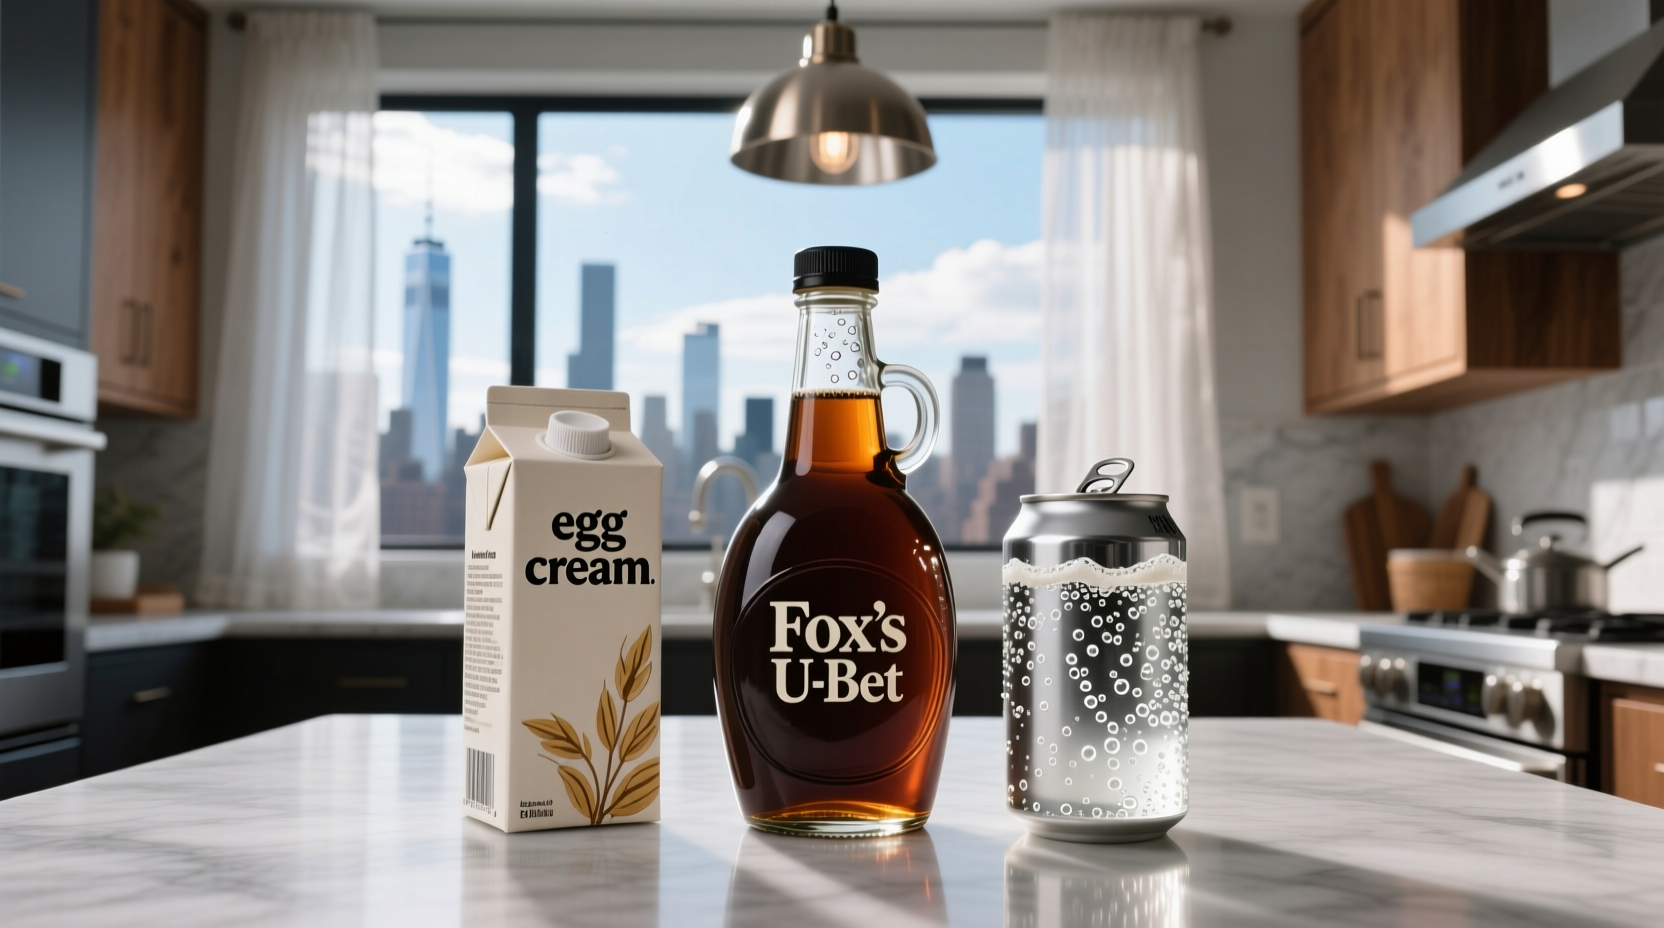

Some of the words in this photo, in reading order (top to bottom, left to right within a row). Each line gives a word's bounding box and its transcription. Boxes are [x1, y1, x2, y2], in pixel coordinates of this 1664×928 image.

[551, 508, 629, 553] egg
[524, 556, 656, 586] cream.
[769, 600, 907, 653] Fox's
[770, 658, 904, 704] U-Bet
